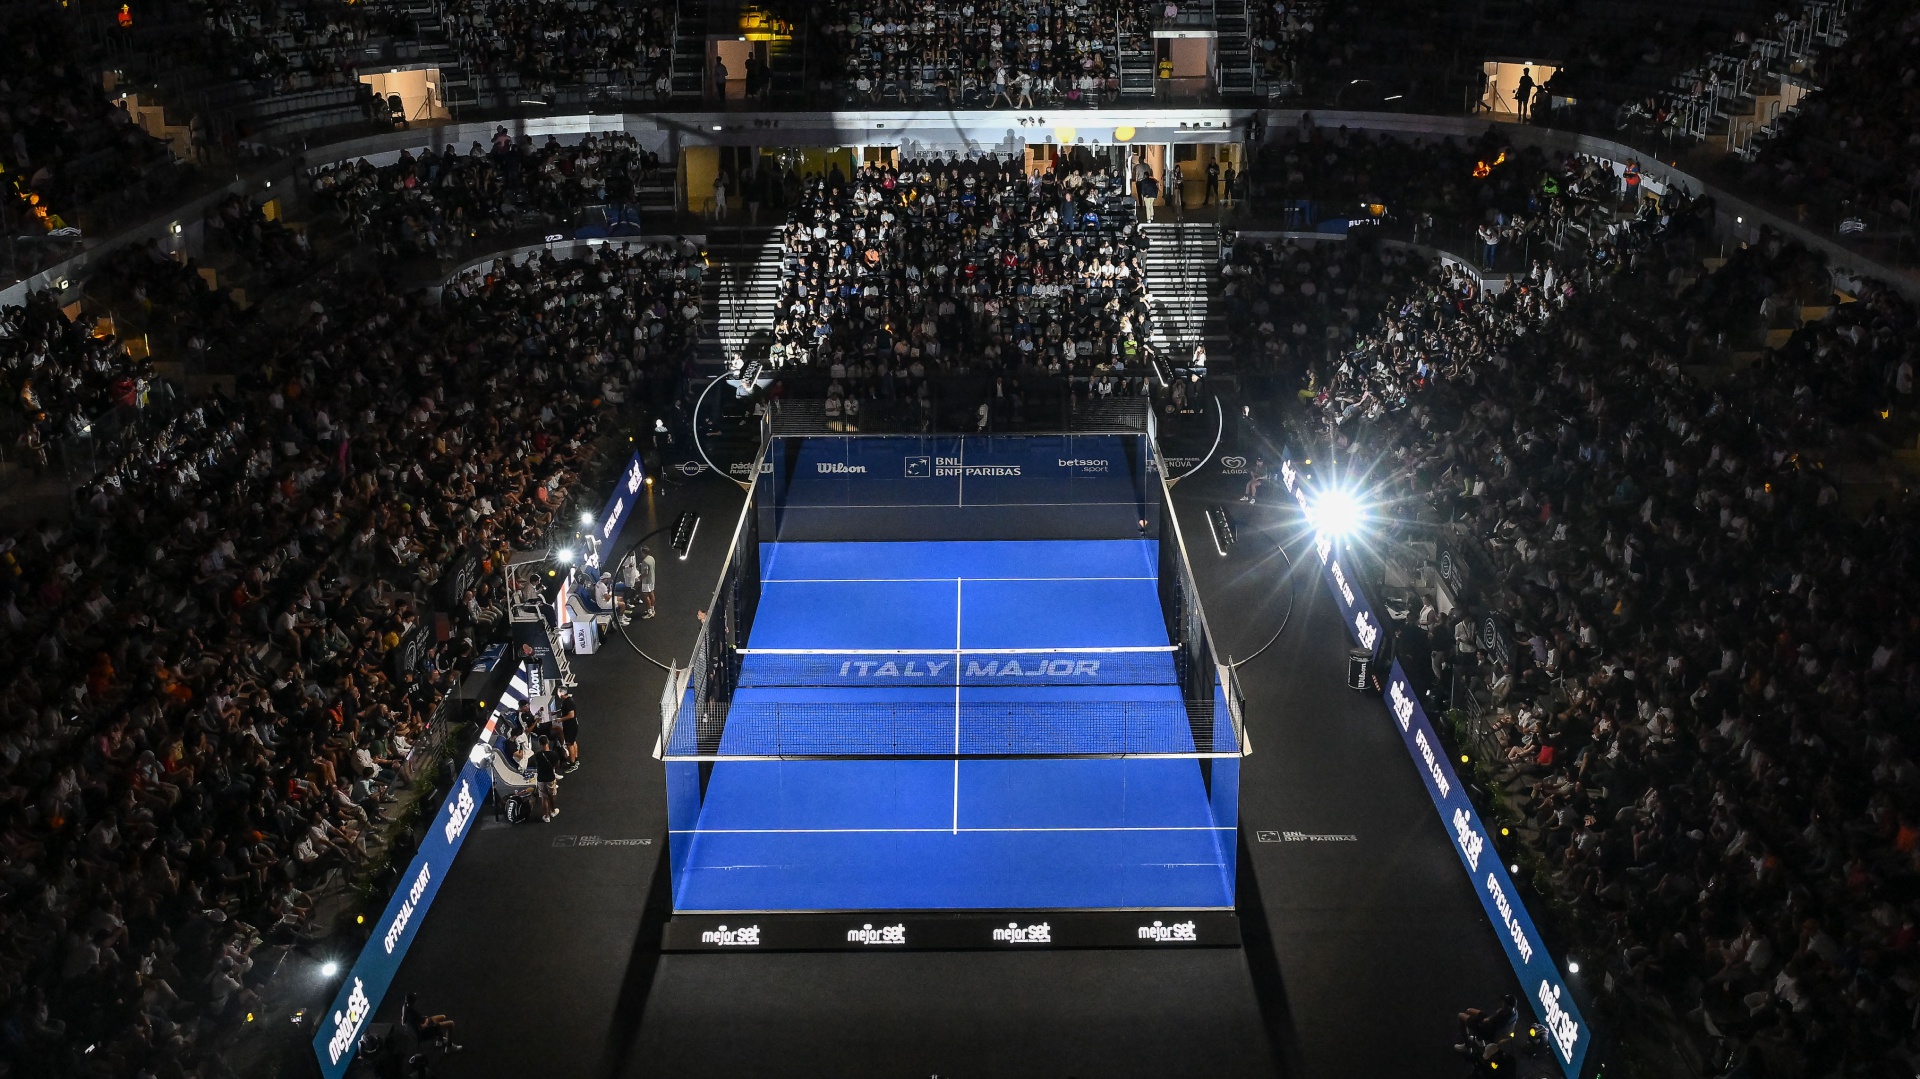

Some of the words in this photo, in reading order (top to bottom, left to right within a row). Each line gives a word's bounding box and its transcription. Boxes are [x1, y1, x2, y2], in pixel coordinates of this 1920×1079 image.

[816, 462, 868, 474] Wilson
[935, 457, 962, 466] BNL
[1058, 458, 1109, 467] betsson
[935, 468, 962, 477] BNP
[965, 467, 1022, 476] PARIBAS
[838, 660, 950, 676] ITALY
[965, 659, 1101, 676] MAJOR
[1357, 662, 1367, 688] Wilson
[529, 667, 542, 700] ilson
[384, 899, 414, 955] OFFICIAL
[409, 861, 431, 906] COURT
[1486, 872, 1513, 930] OFFICIAL
[1510, 918, 1533, 965] COURT
